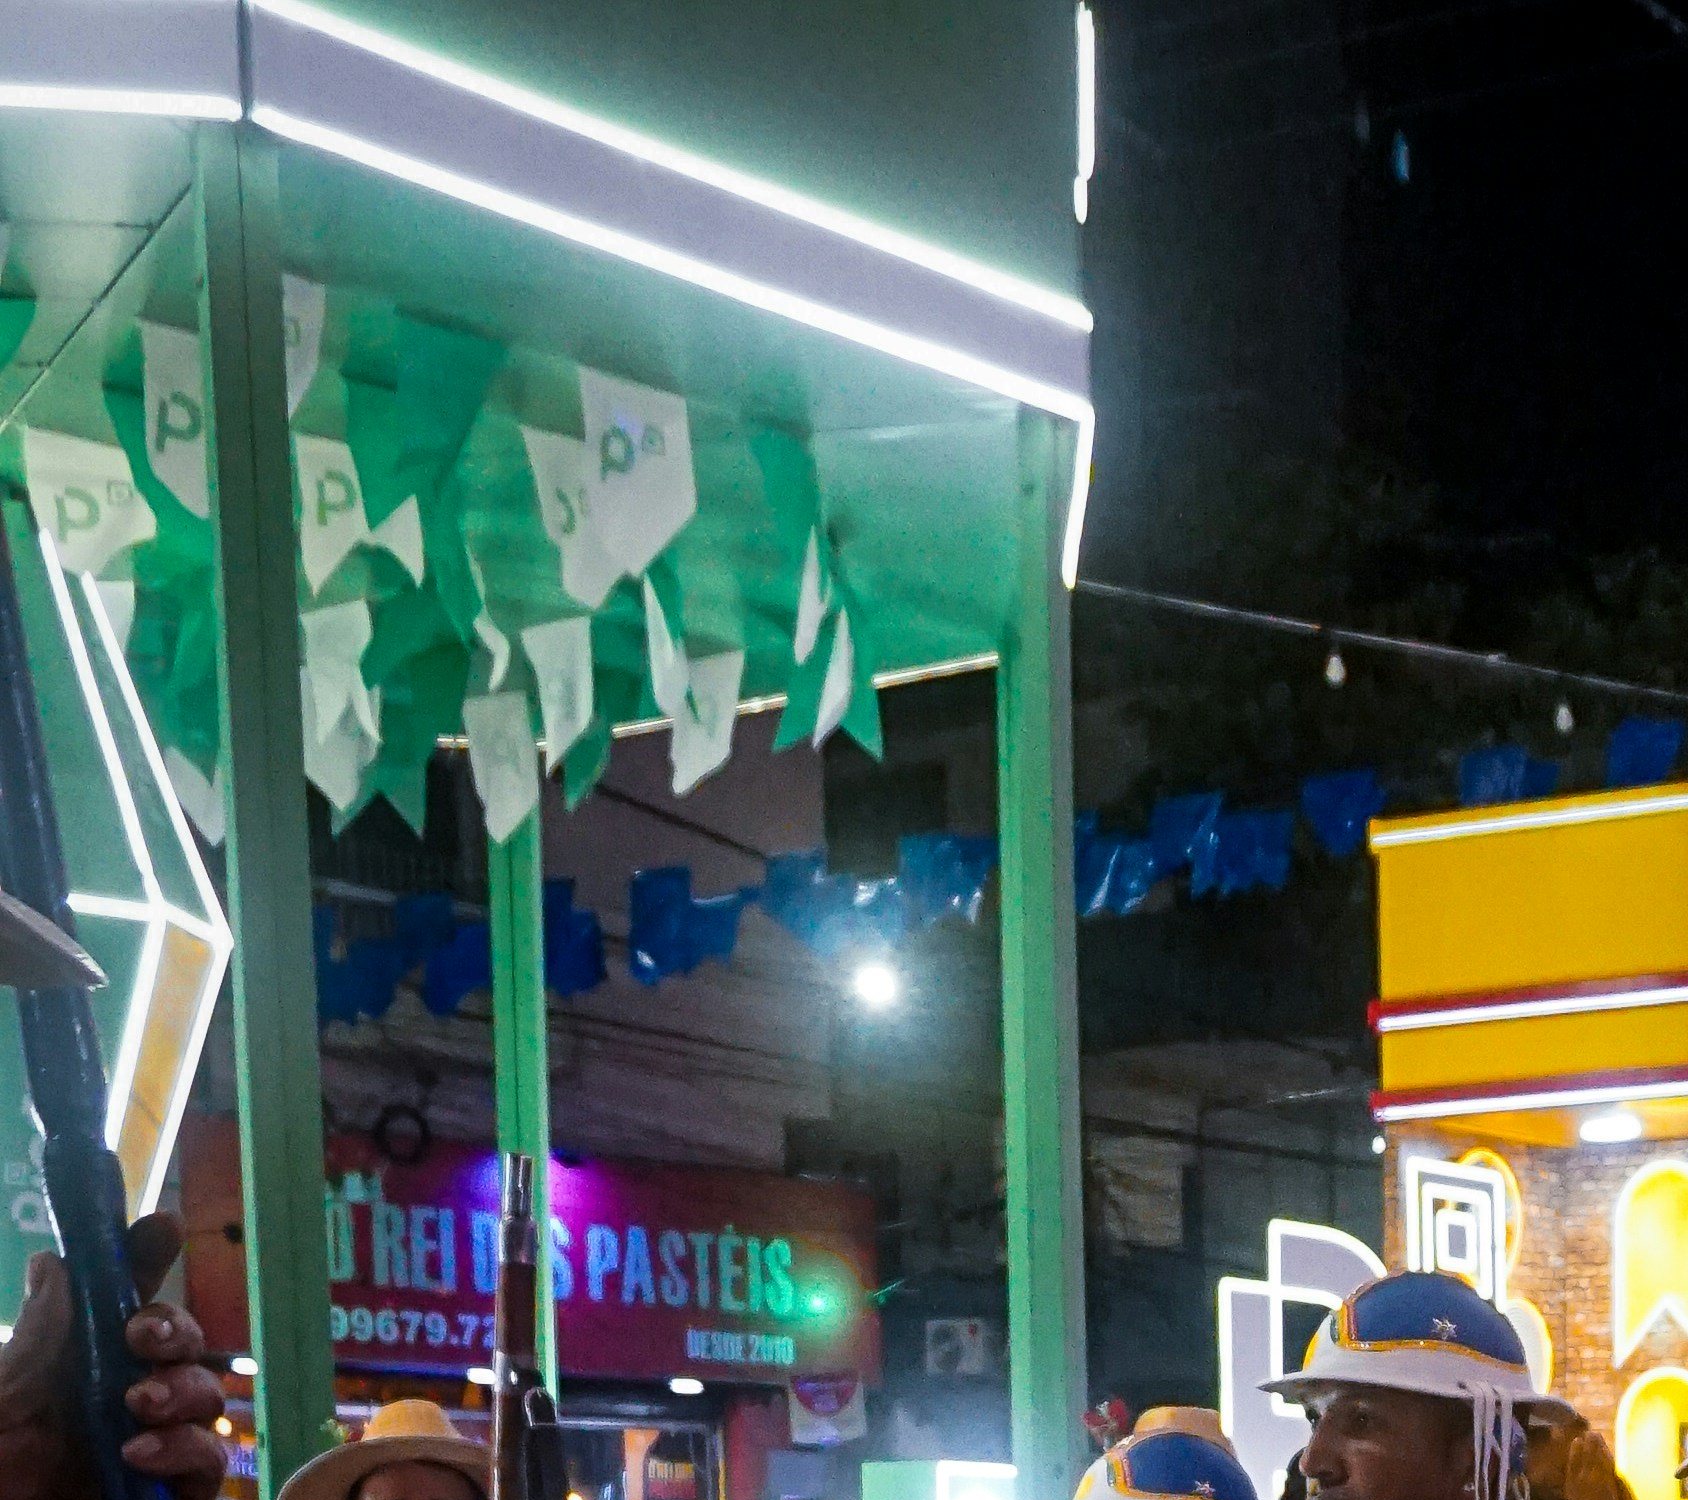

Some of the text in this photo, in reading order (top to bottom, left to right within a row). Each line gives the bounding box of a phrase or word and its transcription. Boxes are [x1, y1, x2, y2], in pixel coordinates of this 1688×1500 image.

[373, 1201, 456, 1292] REI
[471, 1210, 577, 1304] DS
[585, 1222, 799, 1319] PASTÉIS
